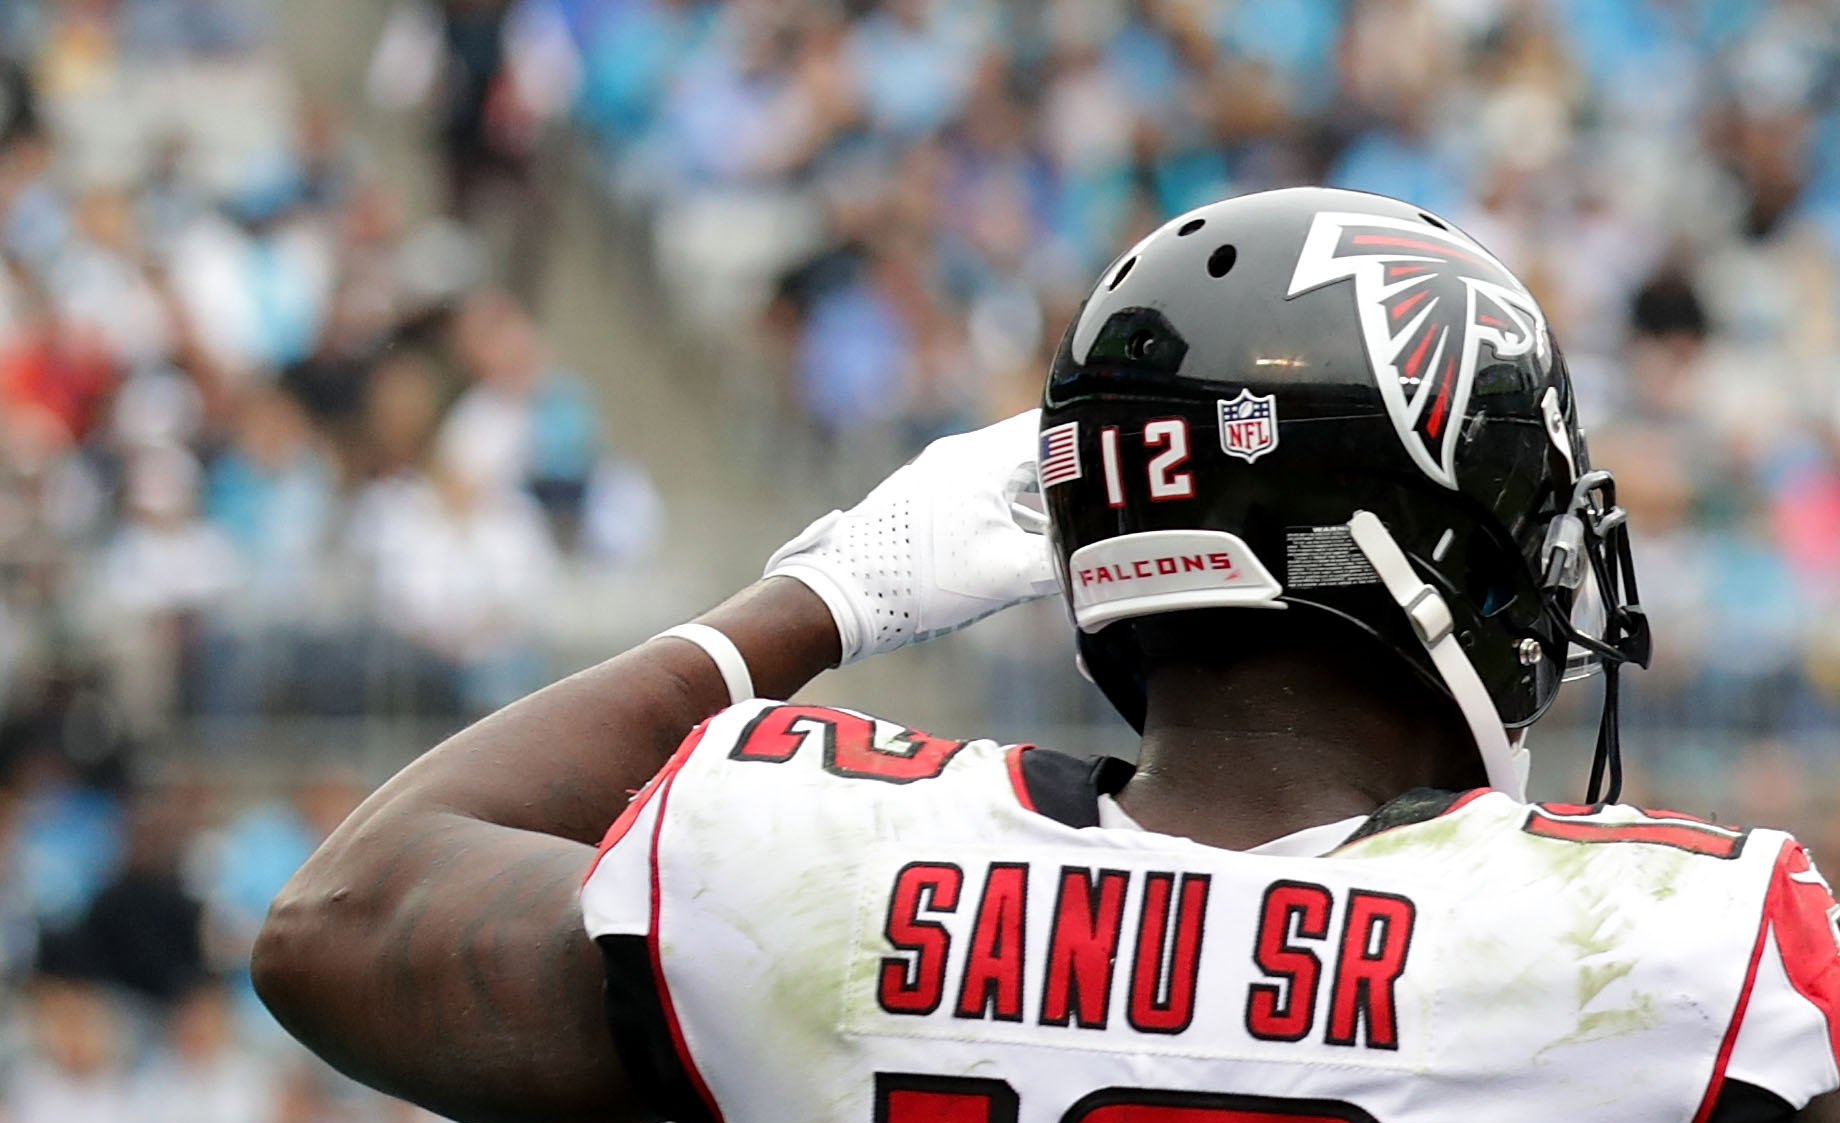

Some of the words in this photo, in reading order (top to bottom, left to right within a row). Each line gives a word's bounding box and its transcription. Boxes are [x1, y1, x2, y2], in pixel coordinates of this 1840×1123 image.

[1100, 416, 1195, 508] 12
[1228, 420, 1269, 449] NFL
[1078, 552, 1232, 587] FALCONS
[876, 861, 1212, 1035] SANU
[1245, 879, 1417, 1051] SR
